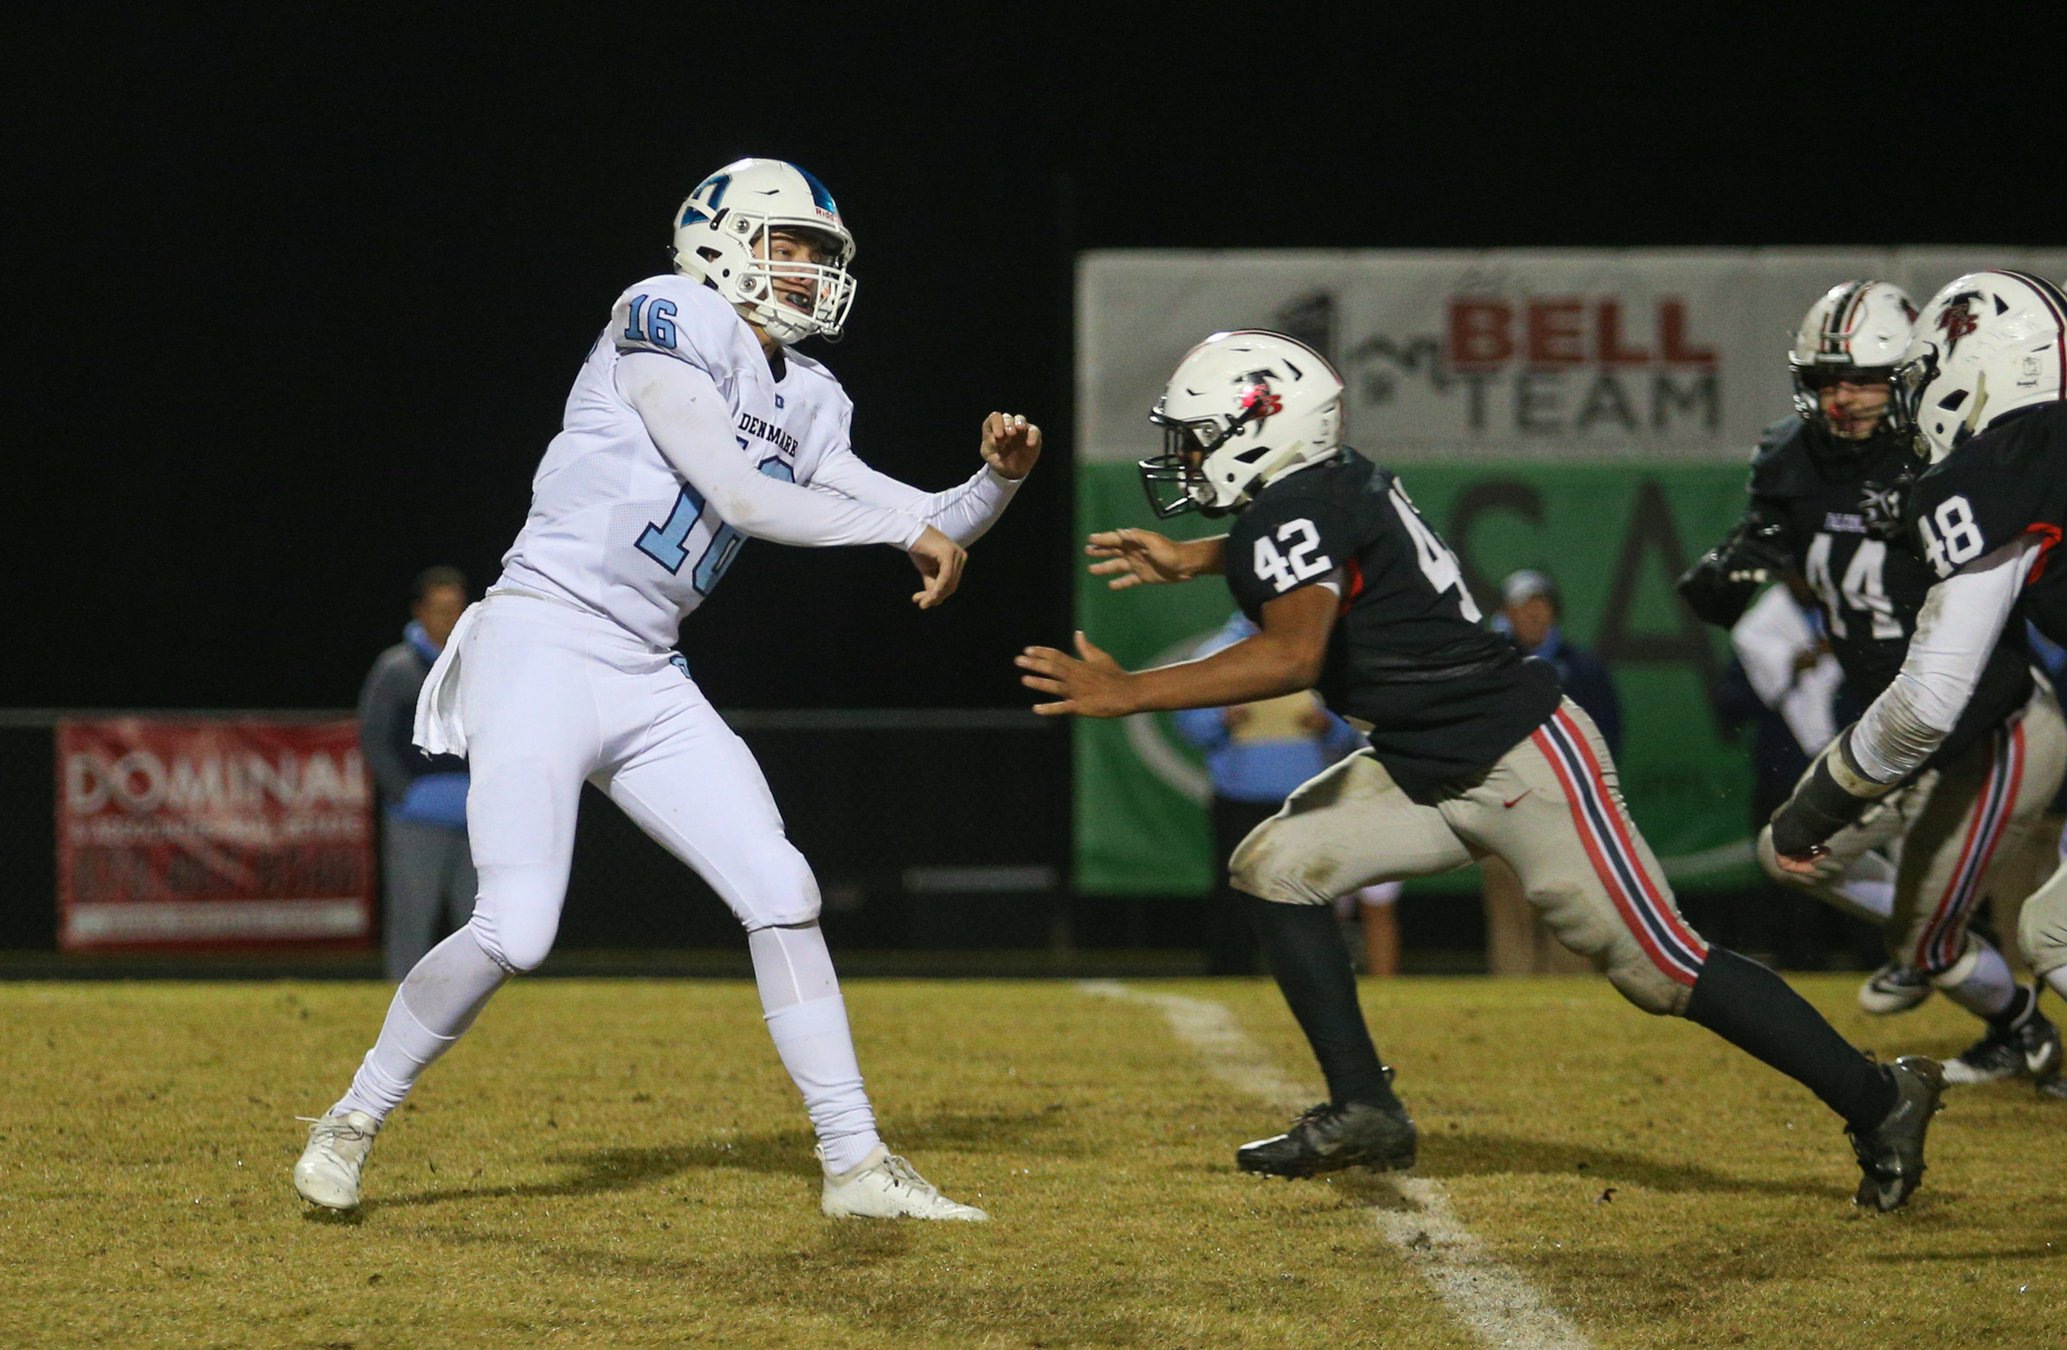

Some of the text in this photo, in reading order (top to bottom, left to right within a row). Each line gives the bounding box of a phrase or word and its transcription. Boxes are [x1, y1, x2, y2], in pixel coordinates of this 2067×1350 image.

[624, 294, 678, 349] 16
[1448, 294, 1720, 369] BELL
[738, 412, 799, 458] DENMARK
[1457, 370, 1722, 434] TEAM
[1253, 518, 1333, 593] 42
[1388, 476, 1483, 624] 4
[1918, 495, 1984, 579] 48
[1805, 532, 1904, 640] 14
